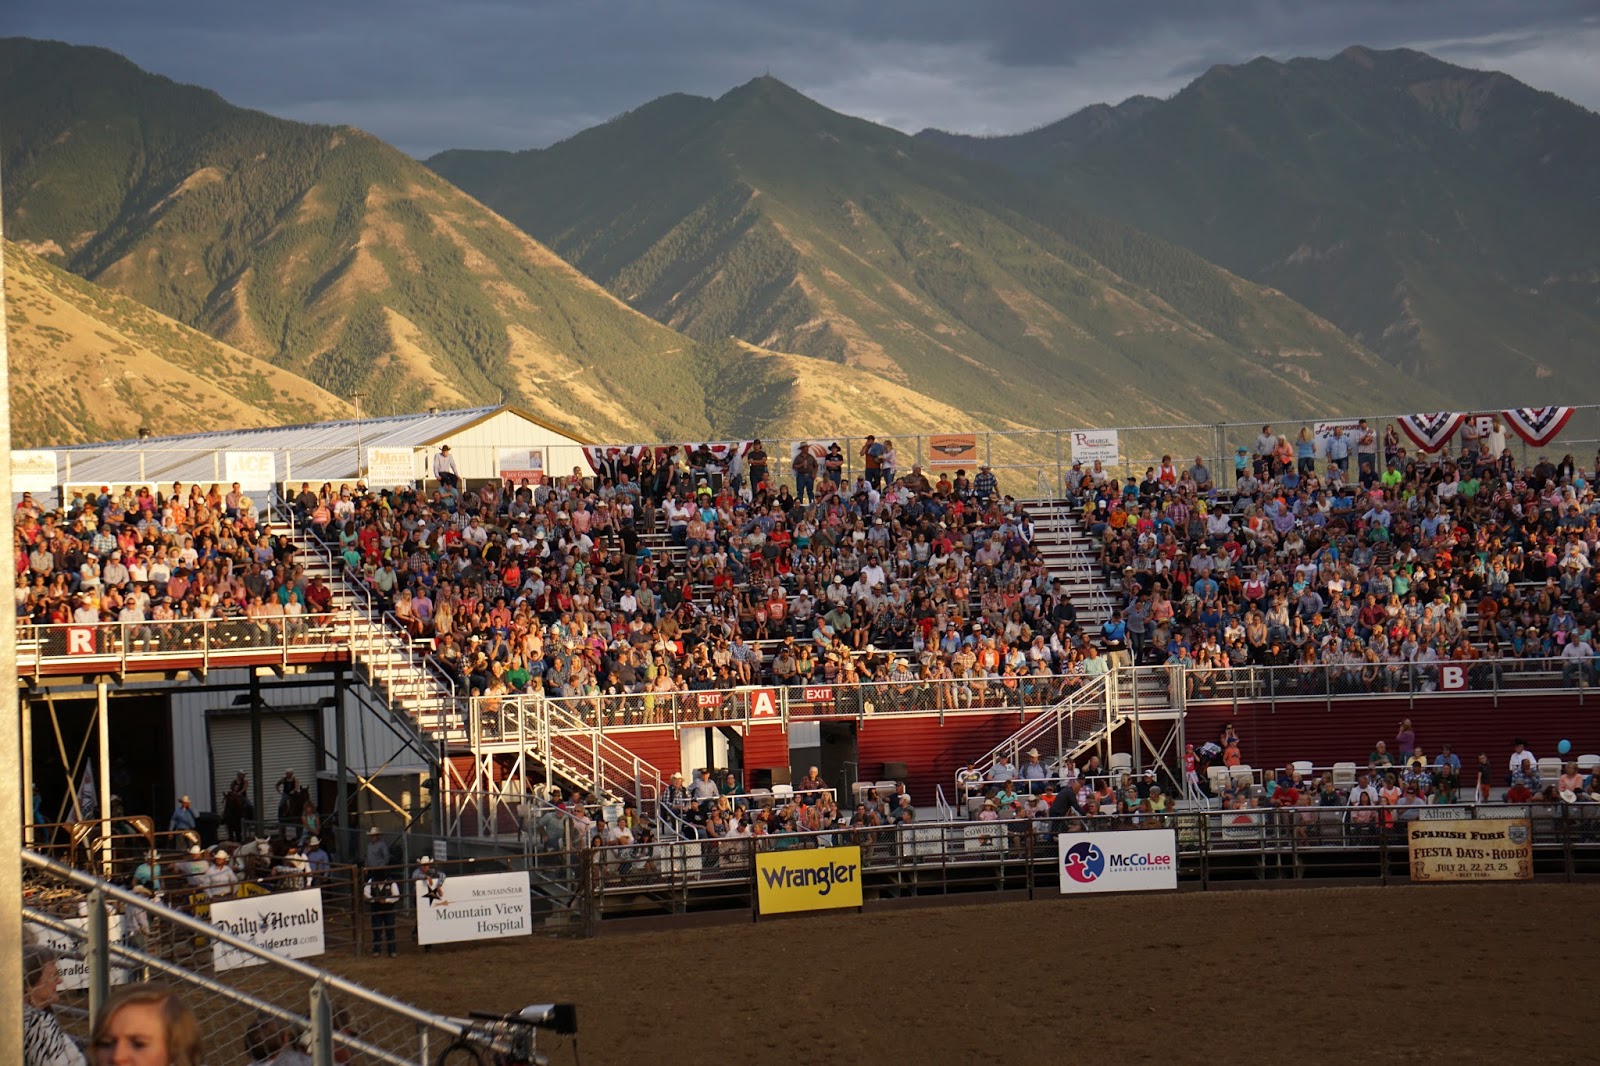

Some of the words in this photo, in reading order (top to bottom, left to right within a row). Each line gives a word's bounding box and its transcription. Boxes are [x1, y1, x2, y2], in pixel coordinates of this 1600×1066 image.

[1476, 416, 1493, 436] B
[70, 629, 93, 652] R
[1443, 666, 1464, 688] B
[698, 694, 721, 705] EXIT
[806, 689, 831, 699] EXIT
[753, 692, 775, 716] A
[1424, 807, 1460, 819] Allan's
[1411, 830, 1467, 840] SPANISH
[1470, 831, 1506, 840] FORK
[1110, 853, 1171, 867] McCoLee
[1414, 847, 1453, 859] FIESTA
[1456, 847, 1484, 859] DAYS
[1492, 848, 1529, 860] RODEO
[1435, 864, 1455, 872] JULY
[1498, 863, 1508, 871] 25
[761, 861, 857, 896] Wrangler
[436, 905, 491, 920] Mountain
[495, 903, 524, 915] View
[218, 917, 258, 939] Daily
[270, 908, 319, 930] Herald
[477, 916, 524, 934] Hospital
